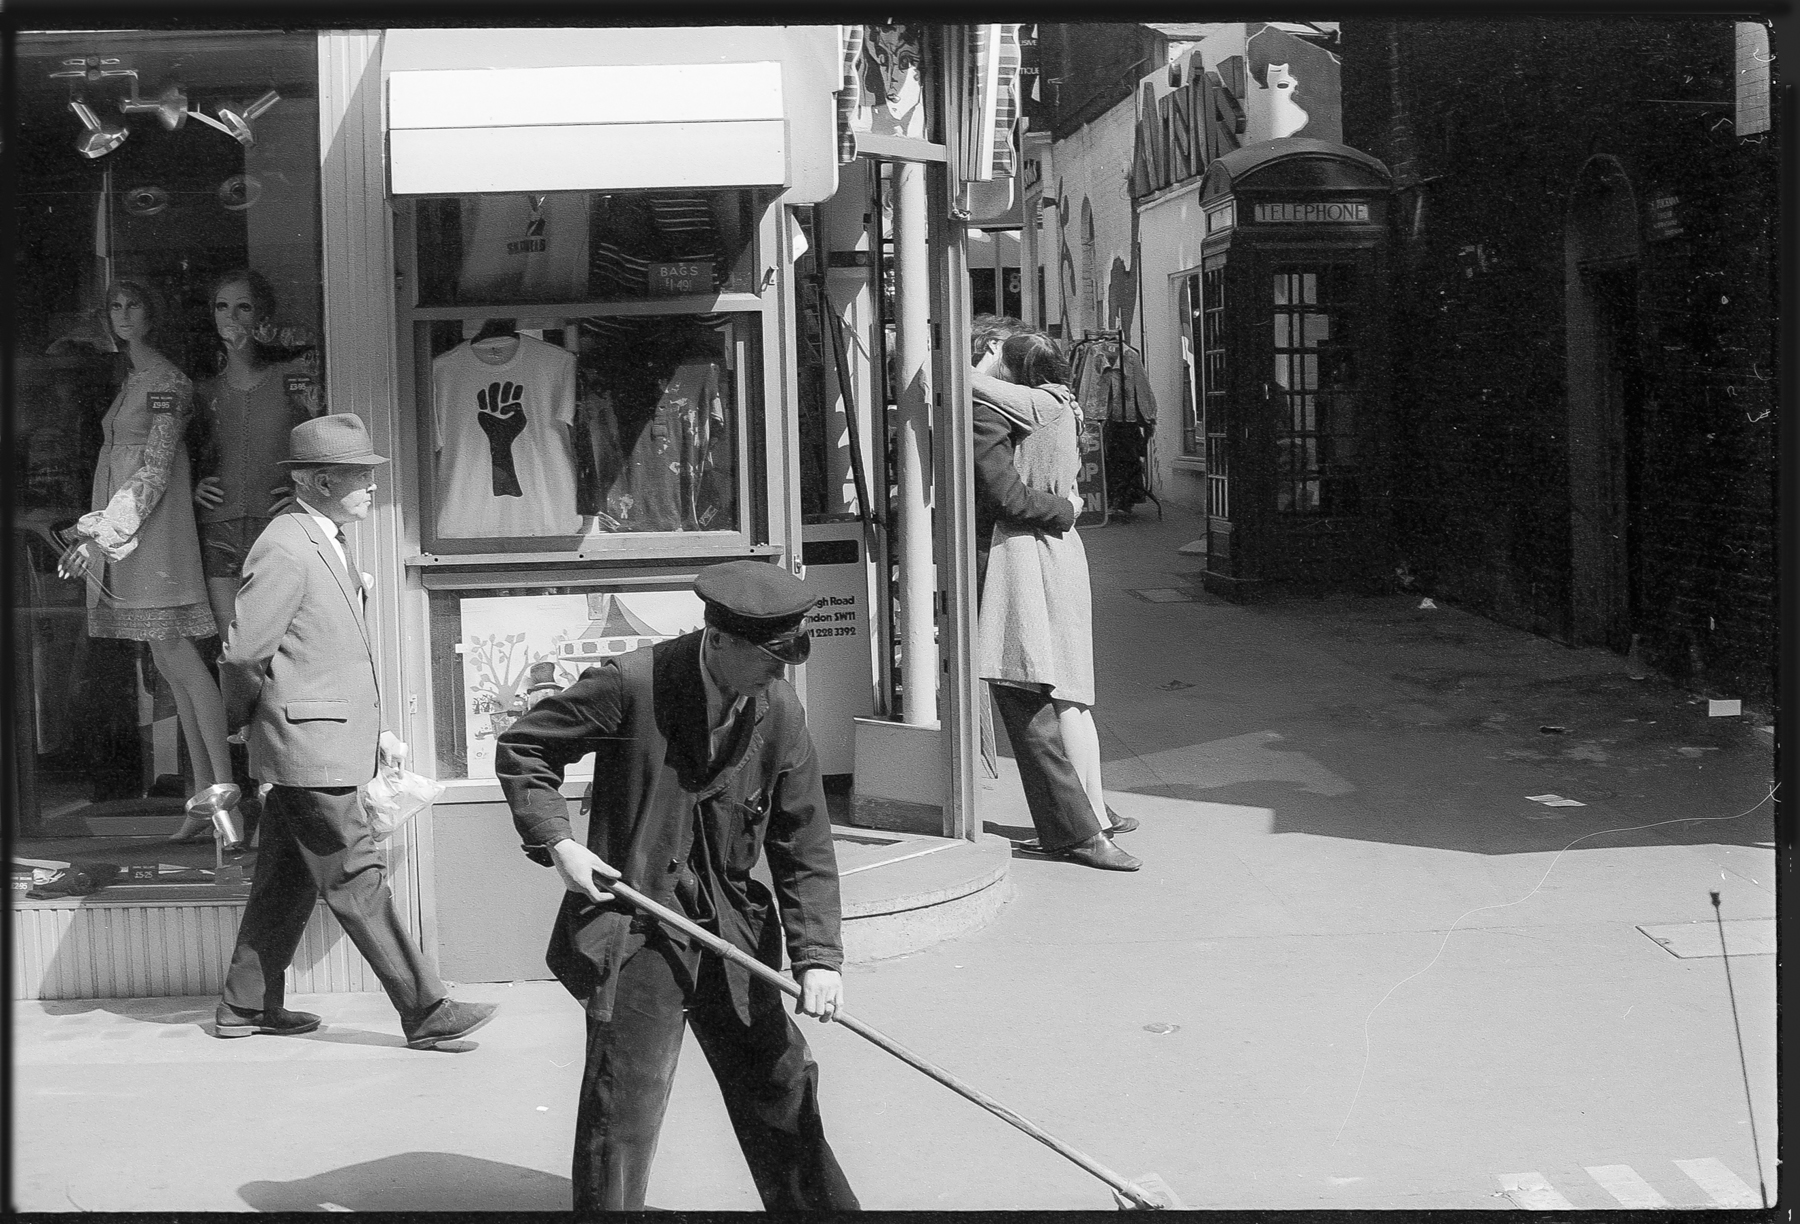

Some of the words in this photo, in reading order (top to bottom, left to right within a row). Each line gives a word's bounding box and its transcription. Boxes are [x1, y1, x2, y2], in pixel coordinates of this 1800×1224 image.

[1257, 203, 1367, 221] TELEPHONE
[660, 266, 699, 277] BAGS
[830, 595, 855, 605] Road
[807, 613, 832, 622] ndon
[834, 611, 856, 621] SW11
[815, 628, 833, 637] 228
[834, 627, 856, 636] 3392
